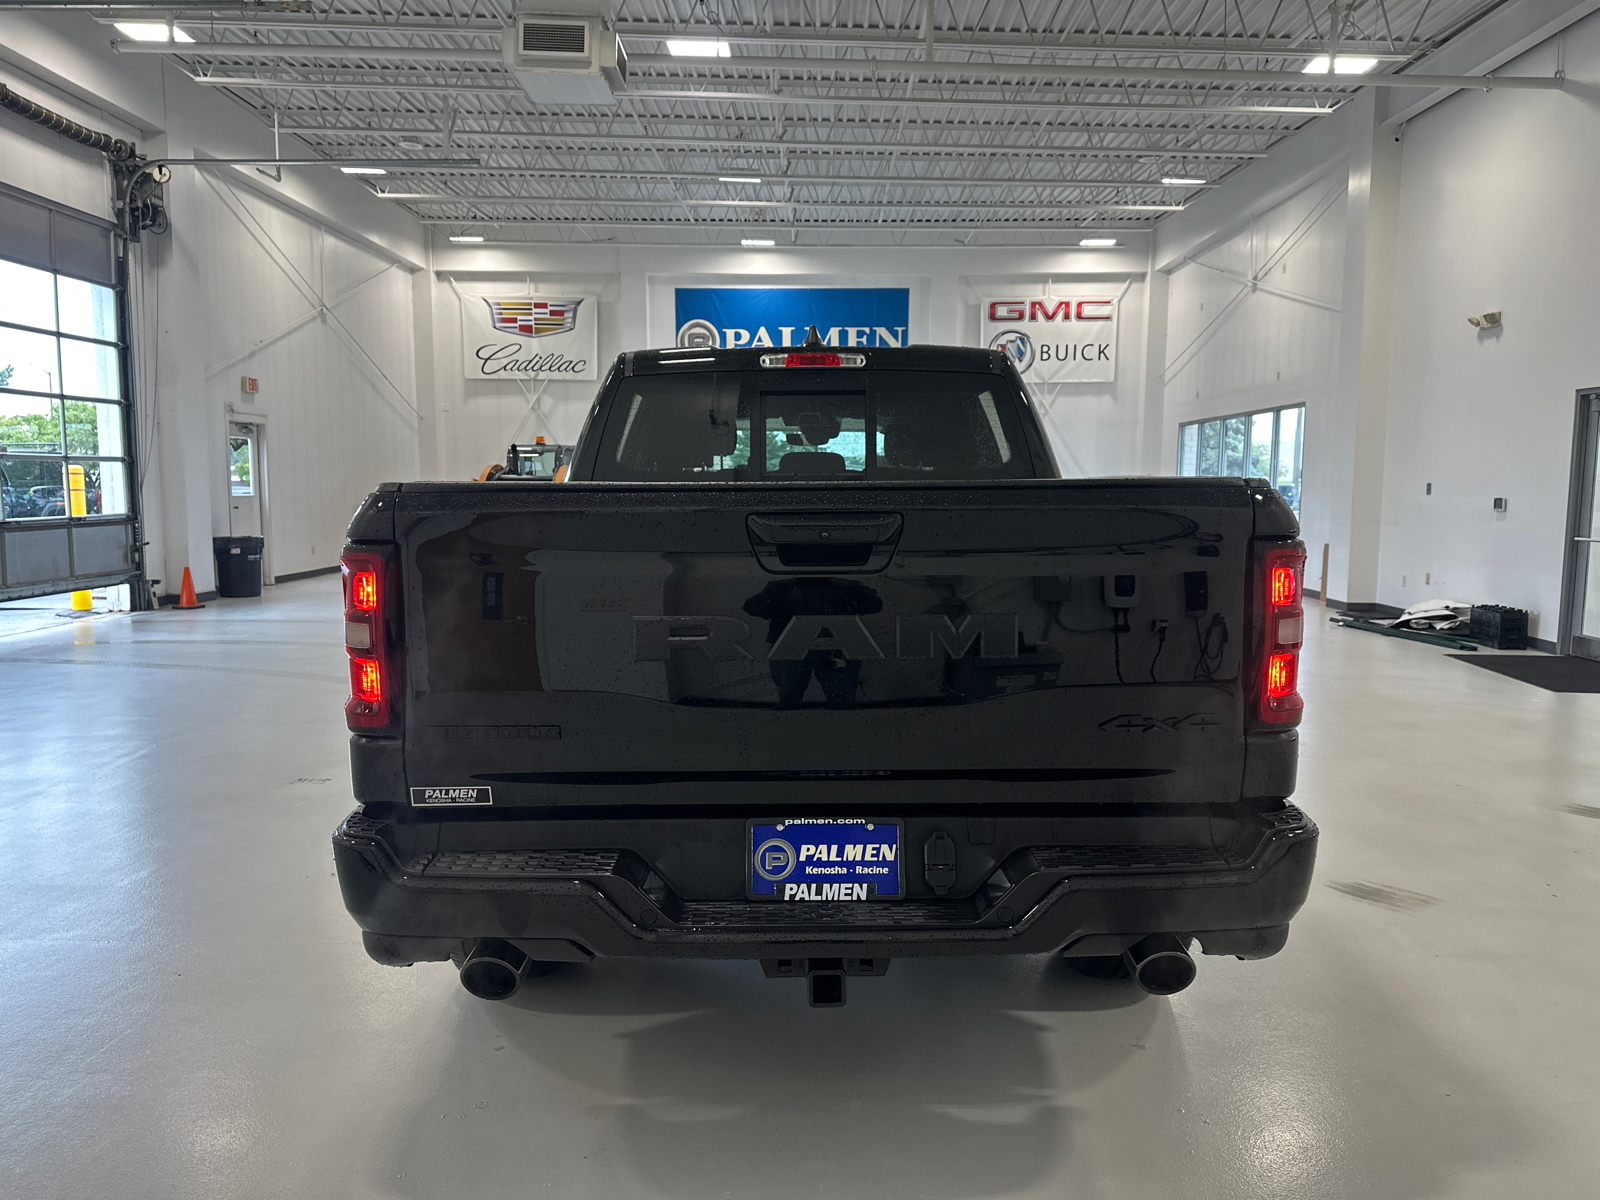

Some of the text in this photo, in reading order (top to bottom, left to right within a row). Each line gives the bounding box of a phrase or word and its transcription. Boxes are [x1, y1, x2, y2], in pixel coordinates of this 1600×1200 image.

[988, 299, 1113, 322] GMC
[475, 343, 587, 375] Cadillac
[1040, 343, 1110, 361] BUICK
[632, 612, 1020, 662] RAM
[424, 788, 478, 799] PALMEN
[785, 818, 866, 826] palmen.com
[799, 844, 897, 862] PALMEN
[805, 865, 848, 875] Kenosha
[855, 865, 890, 875] Racine
[783, 883, 868, 901] PALMEN
